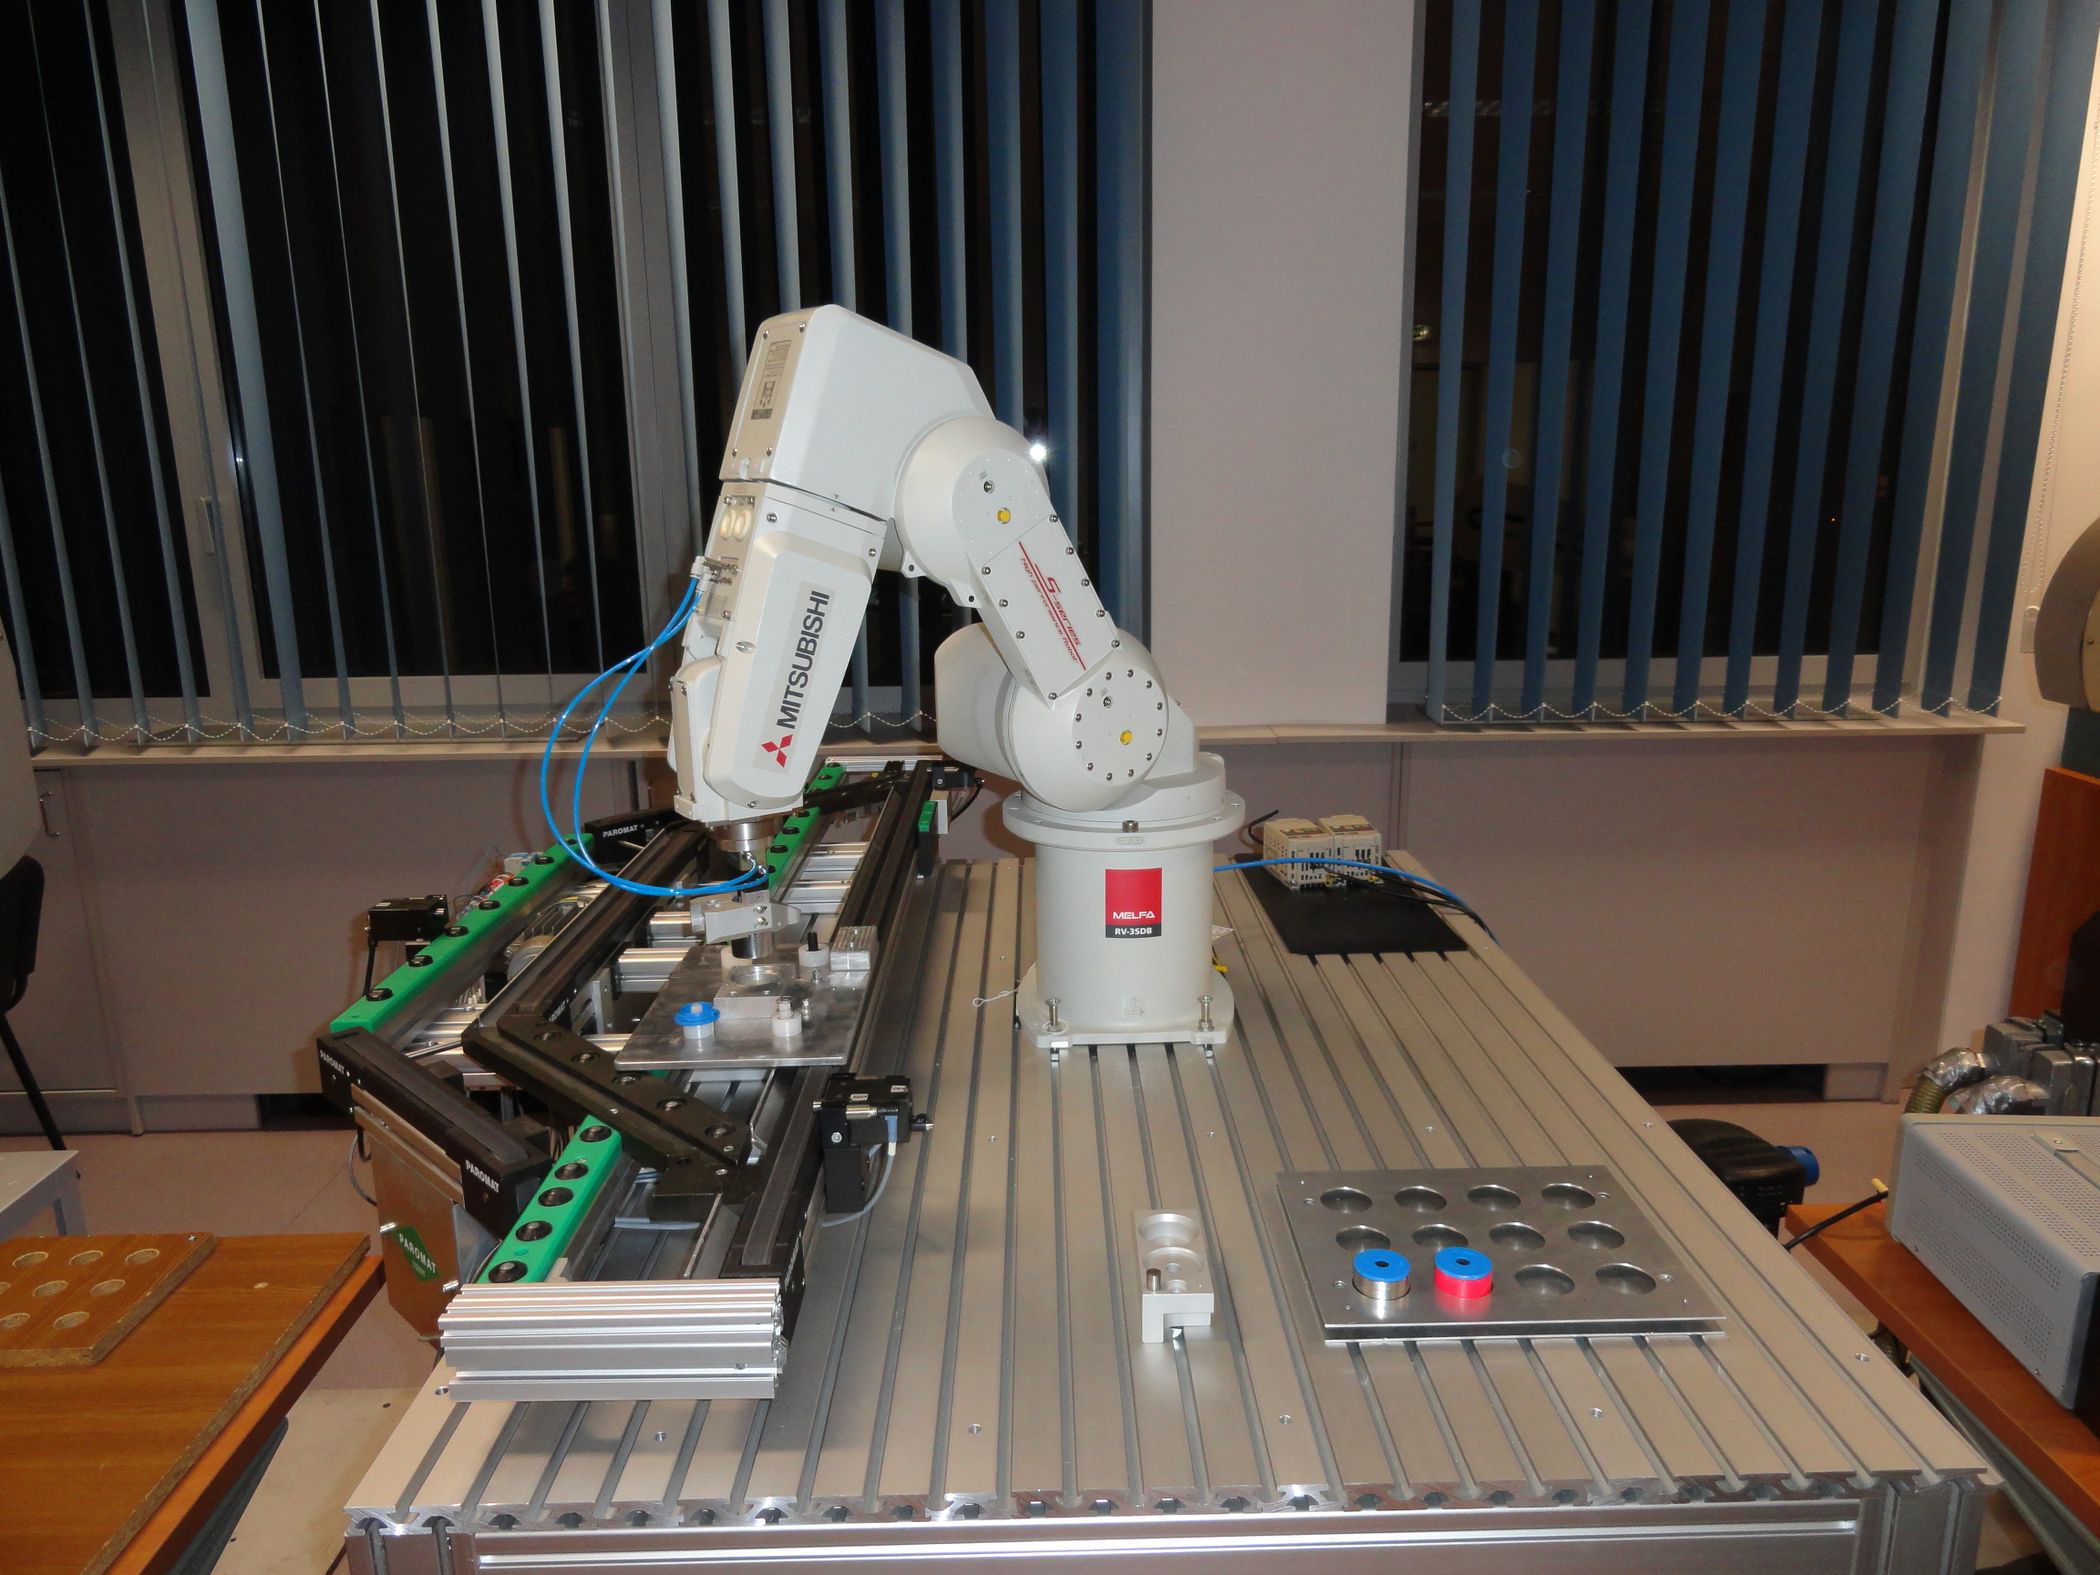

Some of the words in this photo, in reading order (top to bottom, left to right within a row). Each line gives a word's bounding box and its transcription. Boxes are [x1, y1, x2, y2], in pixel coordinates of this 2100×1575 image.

[776, 590, 830, 730] MITSUBISHI
[602, 824, 639, 838] PAROMAT
[1112, 911, 1156, 920] MELFA
[1114, 927, 1153, 935] RV-3SDB
[465, 1159, 499, 1193] PAROMAT
[398, 1232, 437, 1274] PAROMAT
